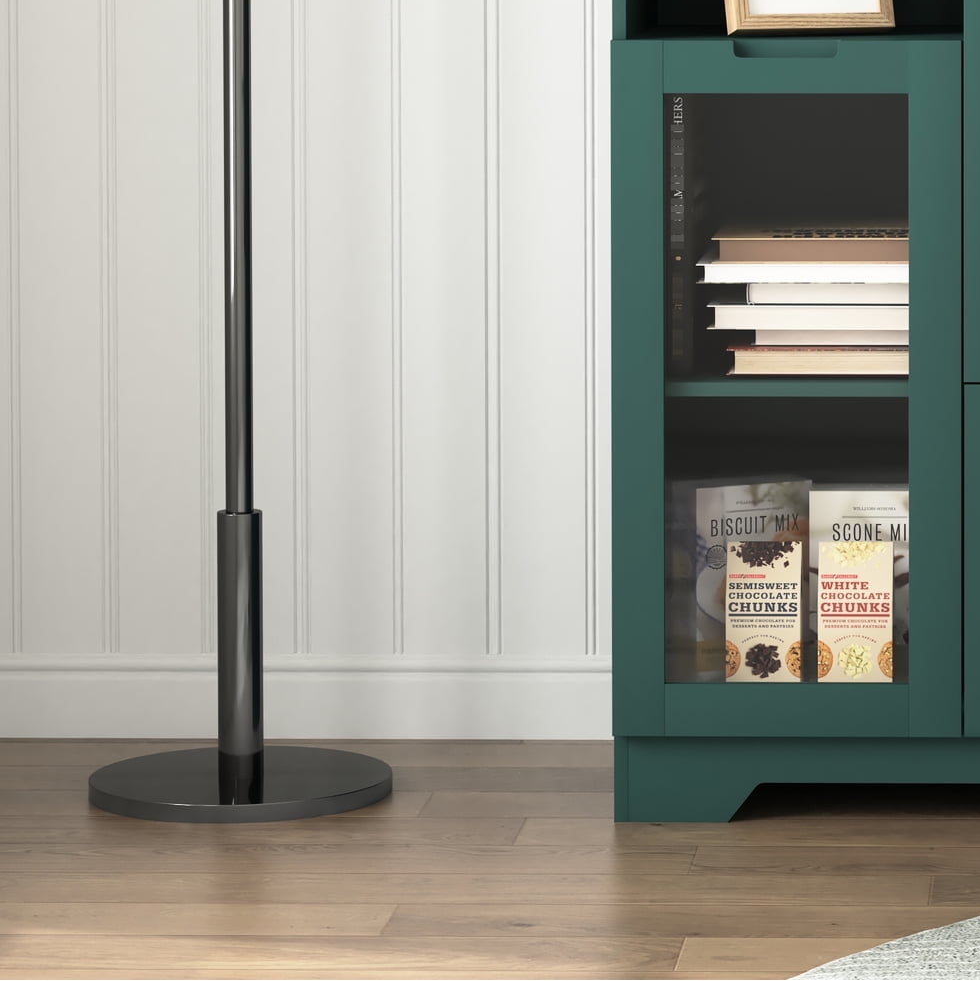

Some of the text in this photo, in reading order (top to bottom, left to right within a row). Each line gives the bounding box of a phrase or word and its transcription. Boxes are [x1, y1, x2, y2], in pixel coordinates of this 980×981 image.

[710, 513, 799, 538] BISCUIT MIX
[832, 523, 907, 542] SCONE MI
[728, 582, 798, 590] SEMISWEET
[821, 581, 869, 590] WHITE
[728, 592, 798, 600] CHOCOLATE
[820, 592, 890, 600] CHOCOLATE
[728, 602, 798, 612] CHUNKS
[820, 602, 890, 613] CHUNKS
